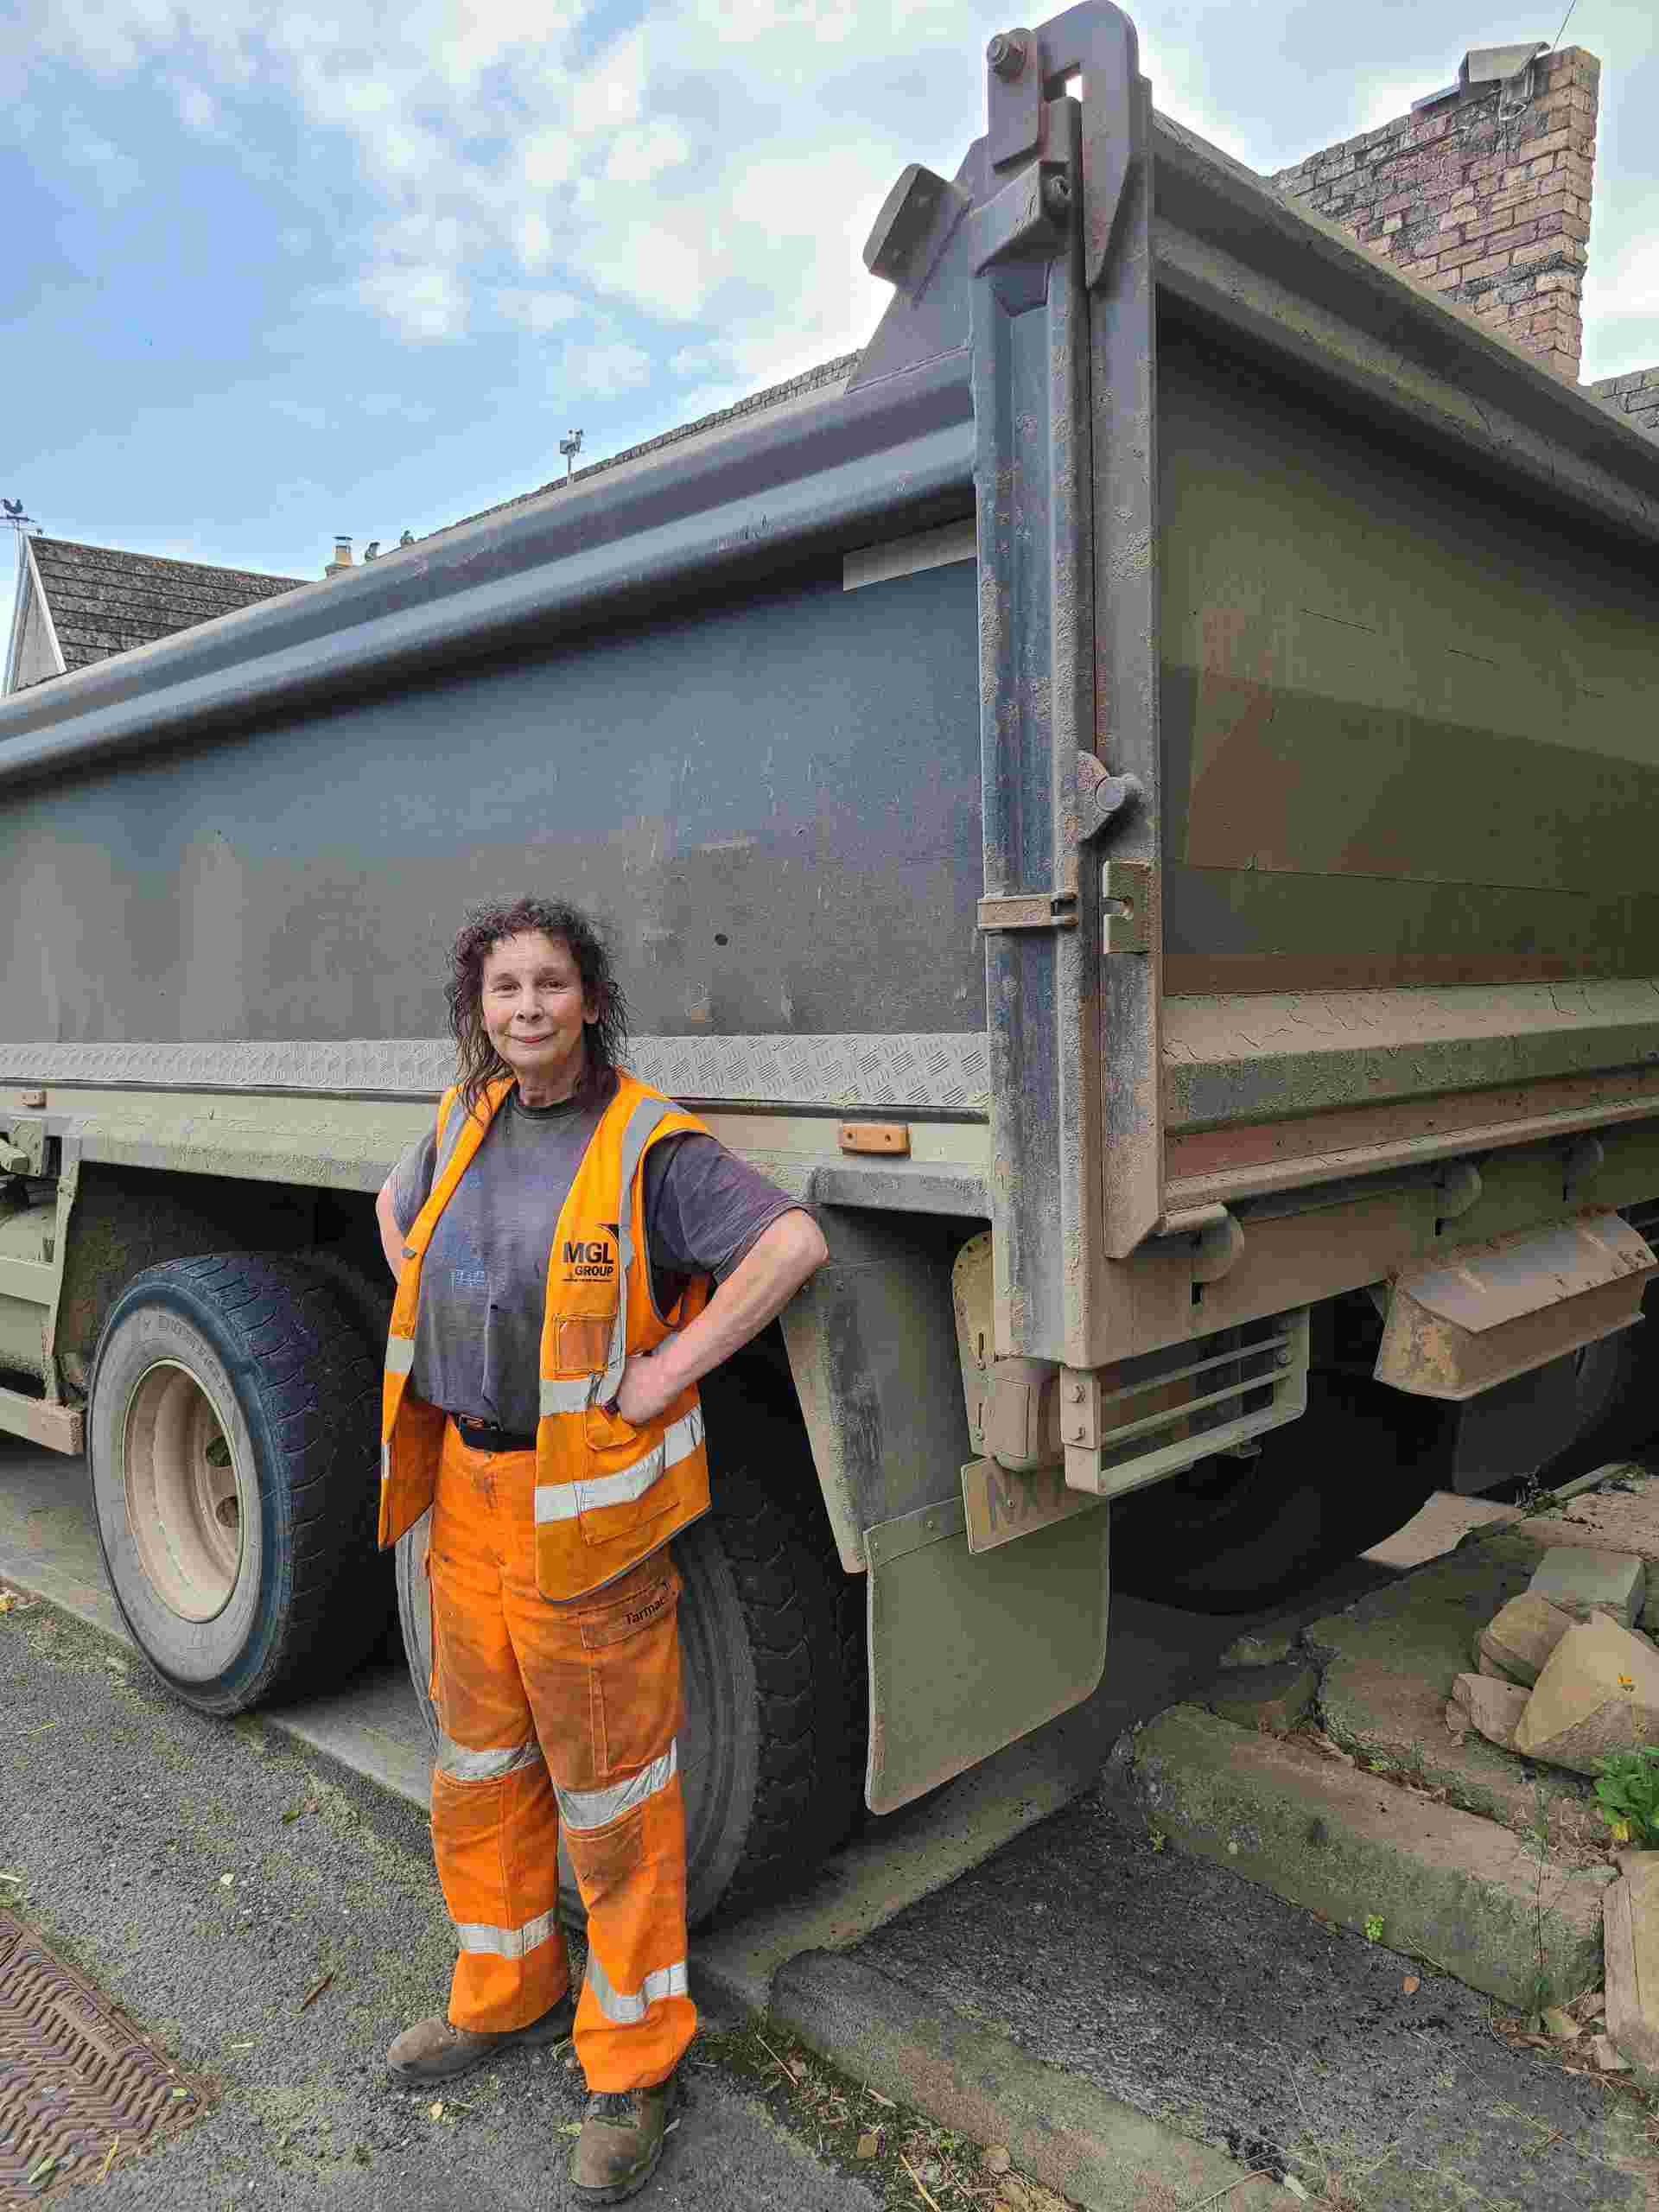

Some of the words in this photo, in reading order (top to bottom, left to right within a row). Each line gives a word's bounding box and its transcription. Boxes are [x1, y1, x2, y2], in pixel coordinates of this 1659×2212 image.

[563, 1242, 614, 1264] MGL
[575, 1266, 613, 1277] GROUP
[623, 1596, 665, 1624] Tarmac
